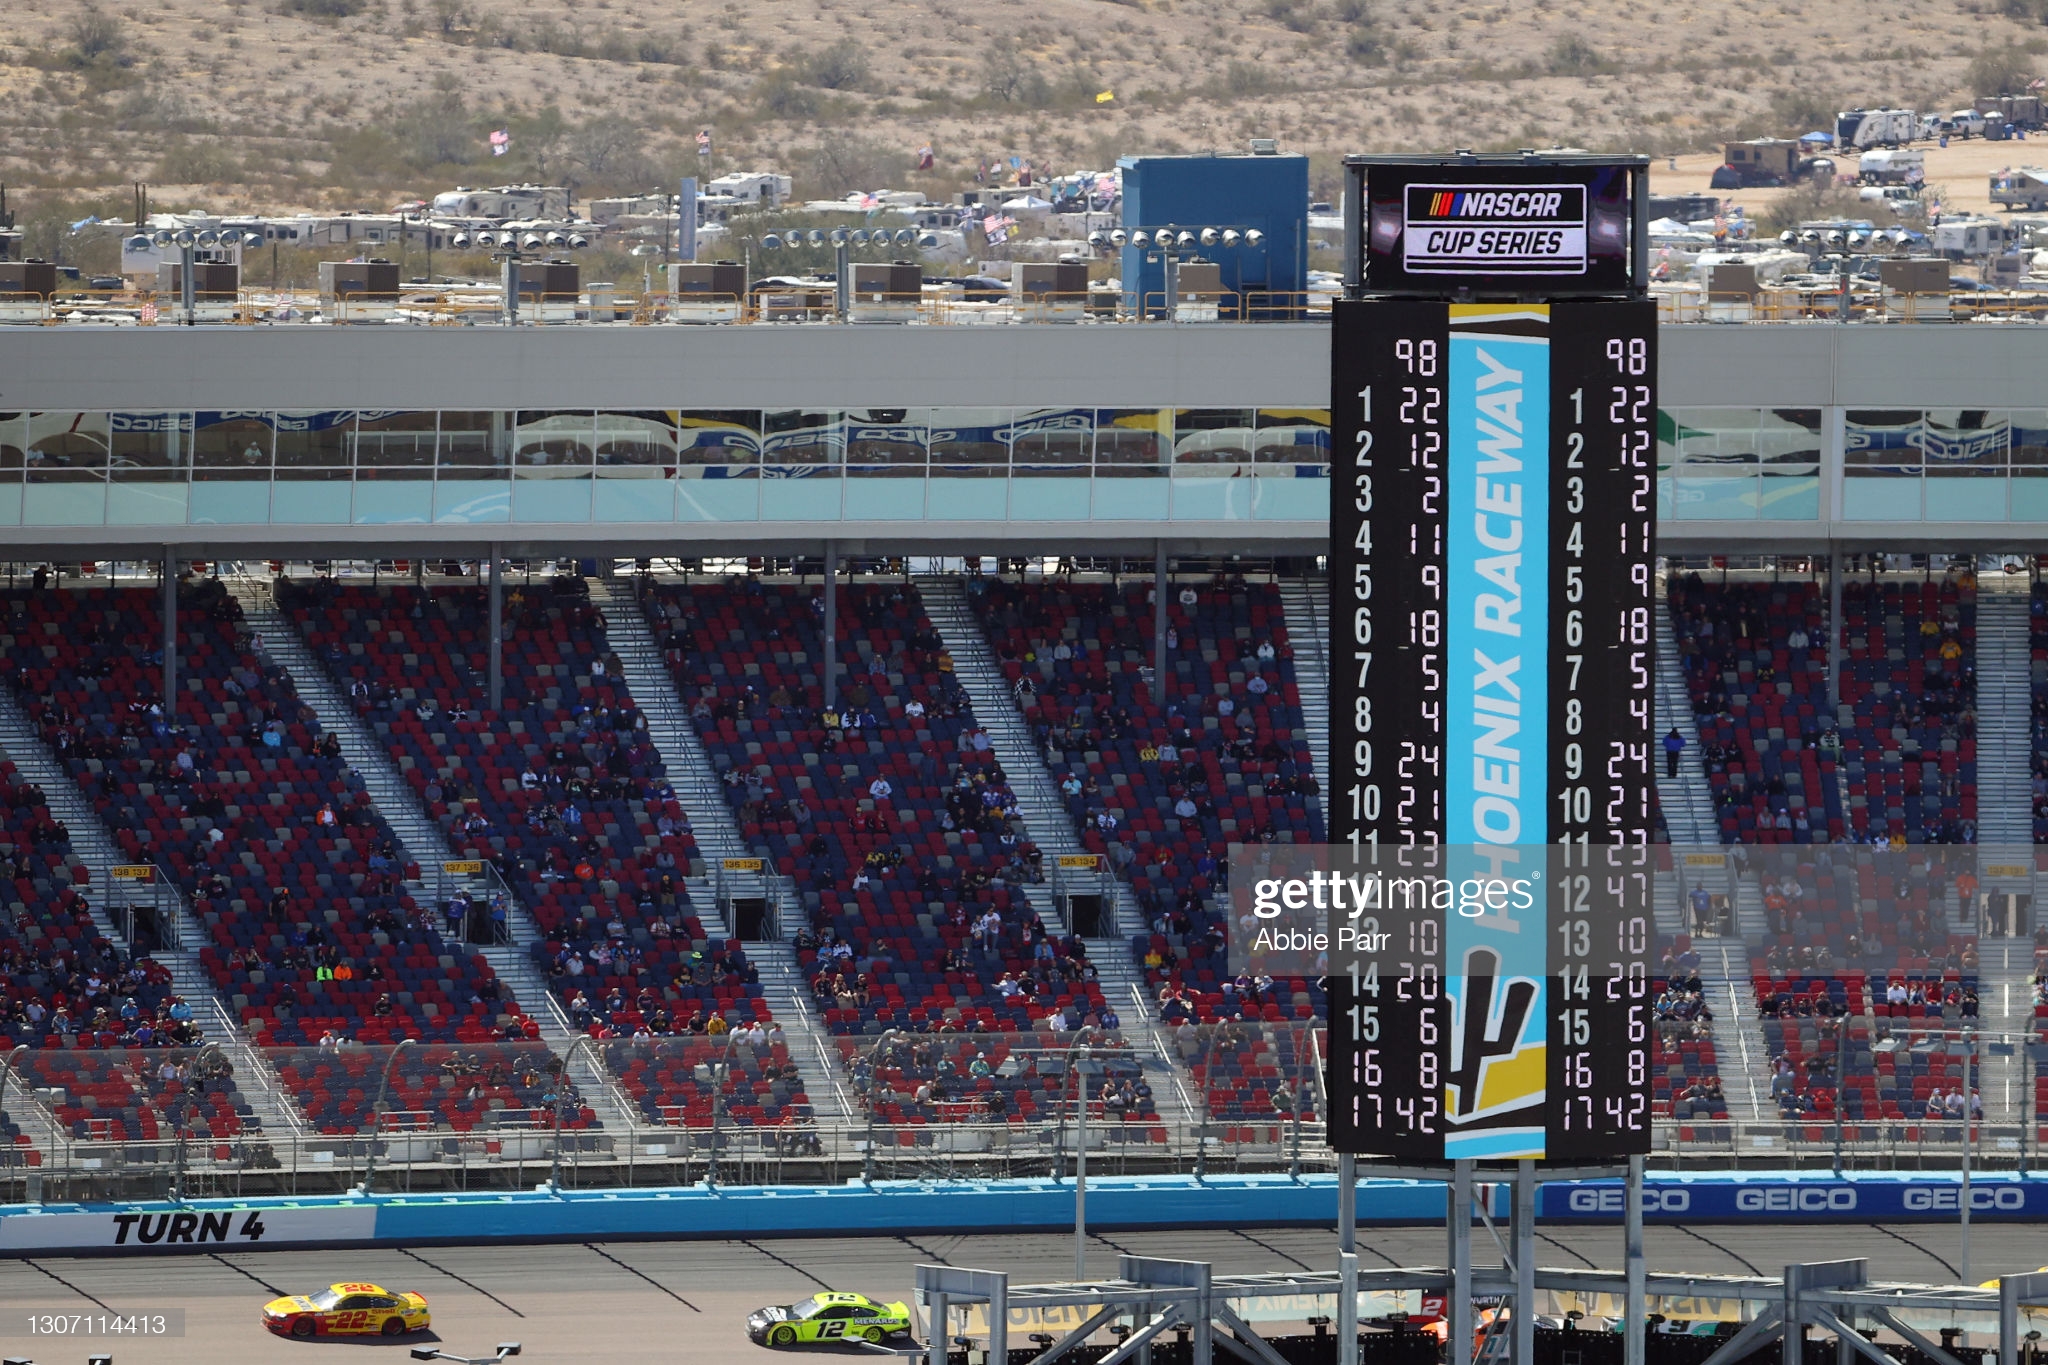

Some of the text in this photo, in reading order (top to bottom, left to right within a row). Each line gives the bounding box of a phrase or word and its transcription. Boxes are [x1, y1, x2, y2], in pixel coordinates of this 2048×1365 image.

[1460, 192, 1562, 217] NASCAR
[1427, 231, 1563, 255] CUP SERIES
[1395, 339, 1437, 376] 98
[1606, 338, 1647, 375] 98
[1357, 385, 1441, 424] 1 22
[1569, 385, 1650, 424] 1 22
[1356, 430, 1441, 469] 2 12
[1567, 430, 1649, 469] 2 12
[1355, 474, 1441, 514] 3 2
[1474, 346, 1523, 637] RACEWAY
[1567, 476, 1584, 514] 3
[1631, 475, 1650, 512] 2
[1355, 520, 1441, 555] 4 11
[1566, 521, 1649, 558] 4 11
[1354, 564, 1440, 600] 5 9
[1566, 564, 1648, 602] 5 9
[1354, 607, 1440, 647] 6 18
[1566, 607, 1648, 647] 6 18
[1354, 652, 1440, 691] 7 5
[1565, 652, 1648, 691] 7 5
[1354, 696, 1439, 733] 8 4
[1565, 698, 1648, 735] 8 4
[1354, 740, 1439, 778] 9 24
[1565, 741, 1647, 780] 9 24
[1347, 784, 1439, 822] 10 21
[1473, 647, 1521, 934] PHOENIX
[1558, 786, 1647, 823] 10 21
[1079, 857, 1095, 865] 134
[1346, 828, 1439, 867] 11 23
[1558, 828, 1647, 868] 11 23
[132, 868, 148, 876] 137
[446, 863, 461, 871] 137
[1558, 873, 1646, 912] 12 47
[1409, 919, 1438, 956] 10
[1558, 917, 1646, 957] 13 10
[1346, 960, 1438, 1000] 14 20
[1558, 961, 1645, 1000] 14 20
[1346, 1004, 1438, 1045] 15 6
[1558, 1005, 1645, 1045] 15 6
[1353, 1049, 1438, 1089] 16 8
[1565, 1049, 1645, 1088] 16 8
[1353, 1094, 1438, 1134] 17 42
[1564, 1093, 1645, 1131] 17 42
[1569, 1189, 1690, 1212] GECO
[1736, 1188, 1857, 1211] GEICO
[1903, 1187, 2025, 1210] GEICO
[113, 1211, 265, 1245] TURN 4
[335, 1310, 369, 1329] 22
[1422, 1298, 1443, 1316] 2
[815, 1321, 847, 1339] 12
